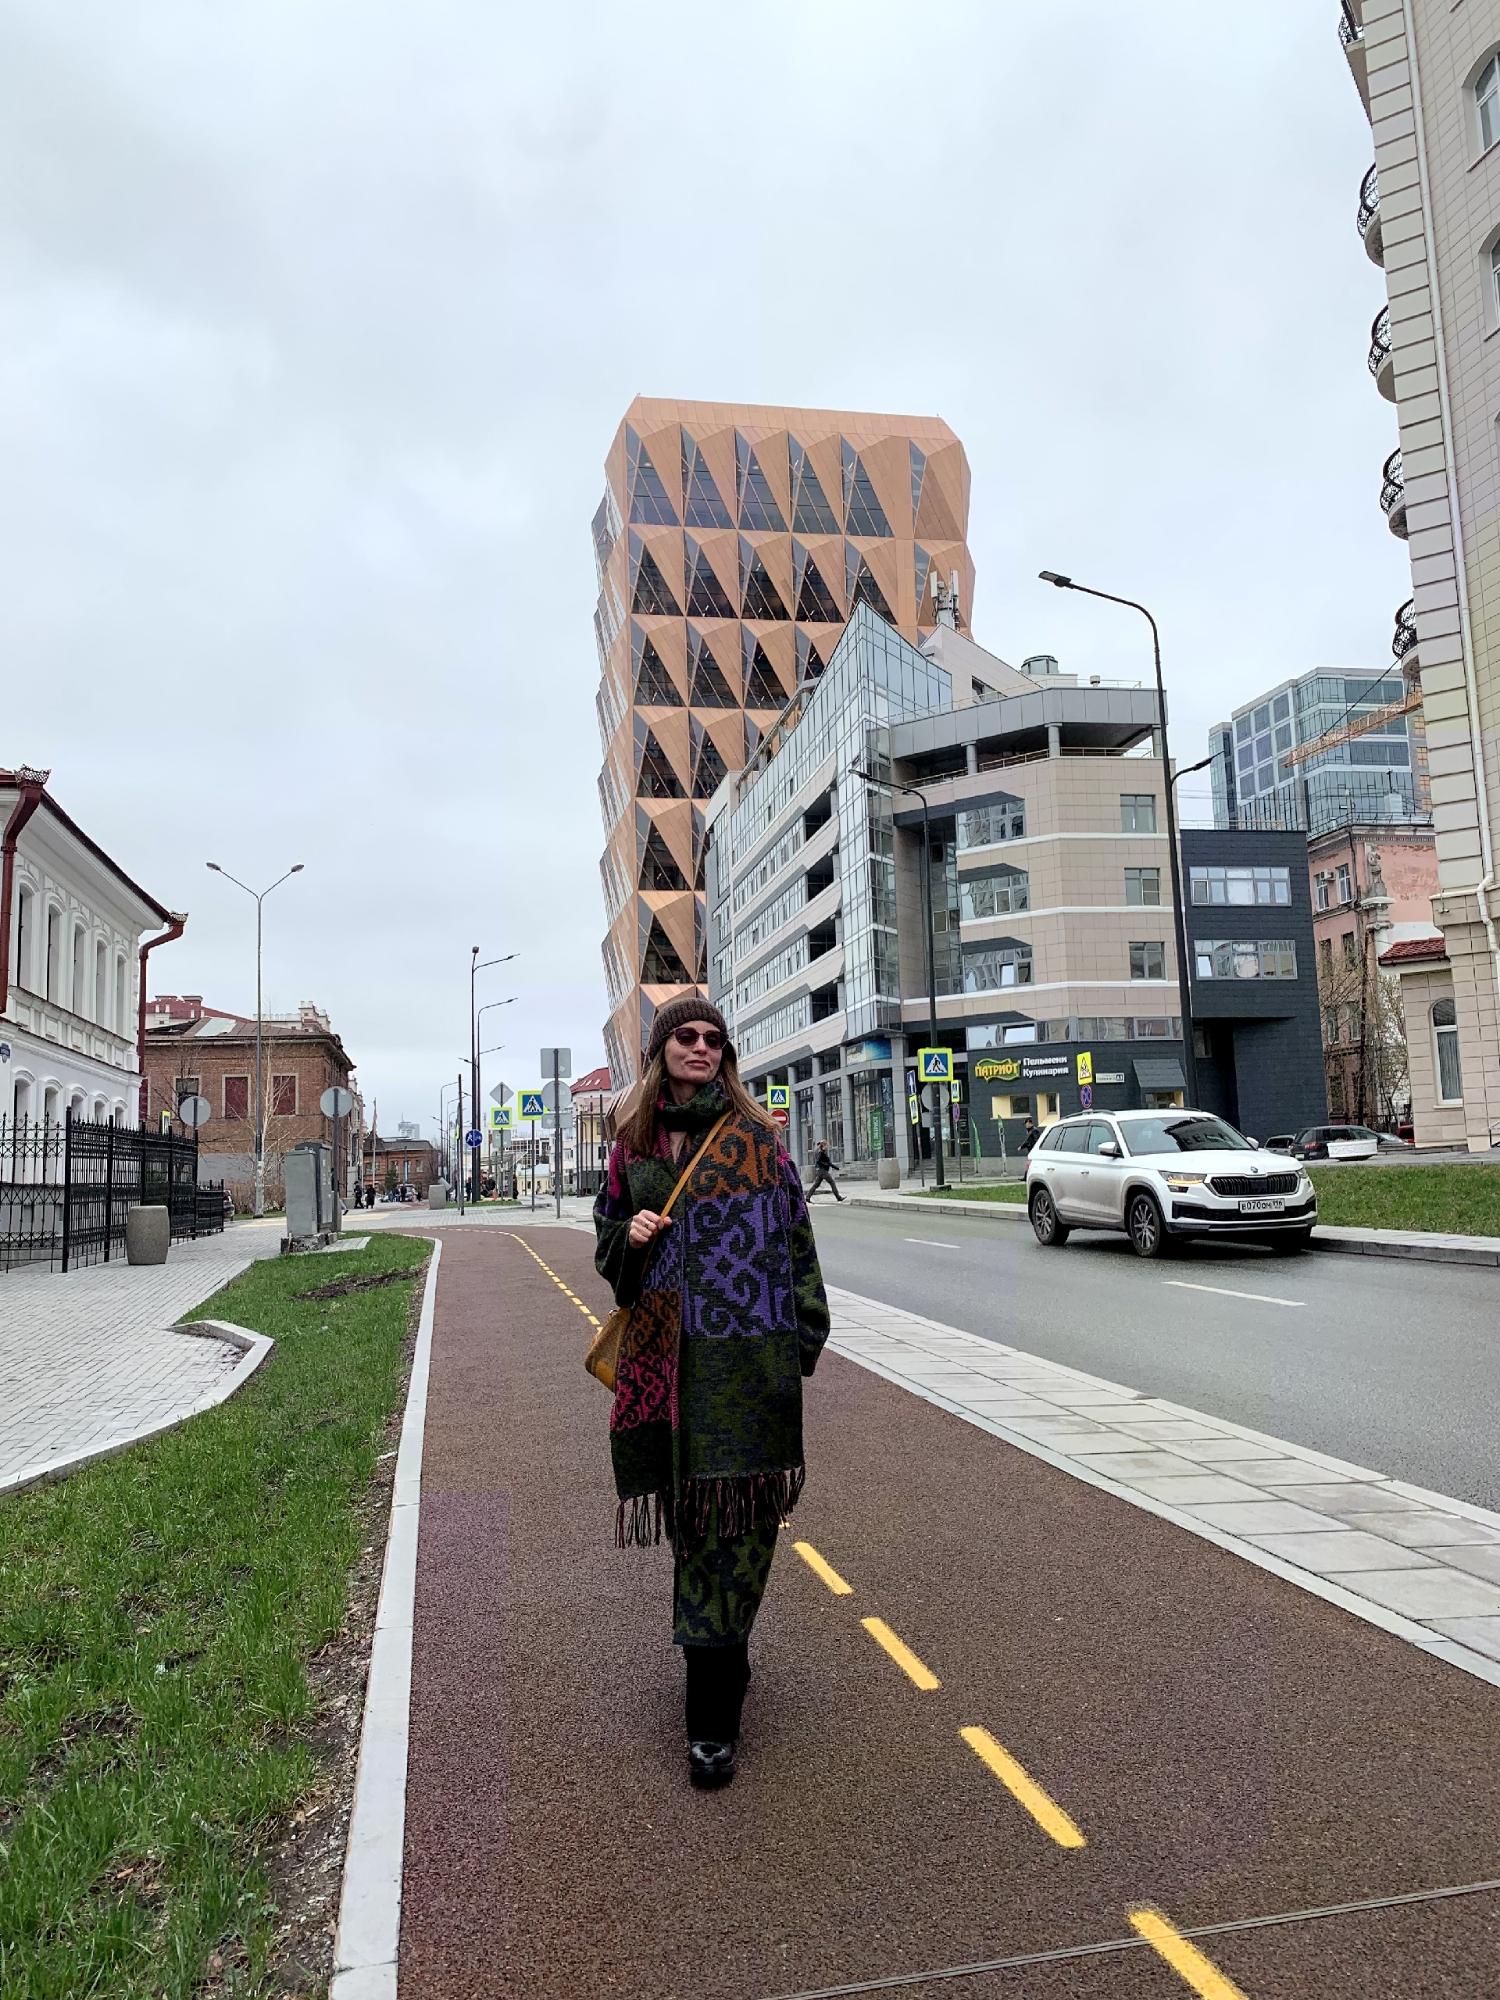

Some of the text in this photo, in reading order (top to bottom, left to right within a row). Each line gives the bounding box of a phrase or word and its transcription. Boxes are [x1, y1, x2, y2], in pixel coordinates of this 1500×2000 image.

[1023, 1056, 1067, 1065] Пельмени
[975, 1063, 1018, 1076] ПАТРИОТ
[1023, 1067, 1069, 1078] Кулинария
